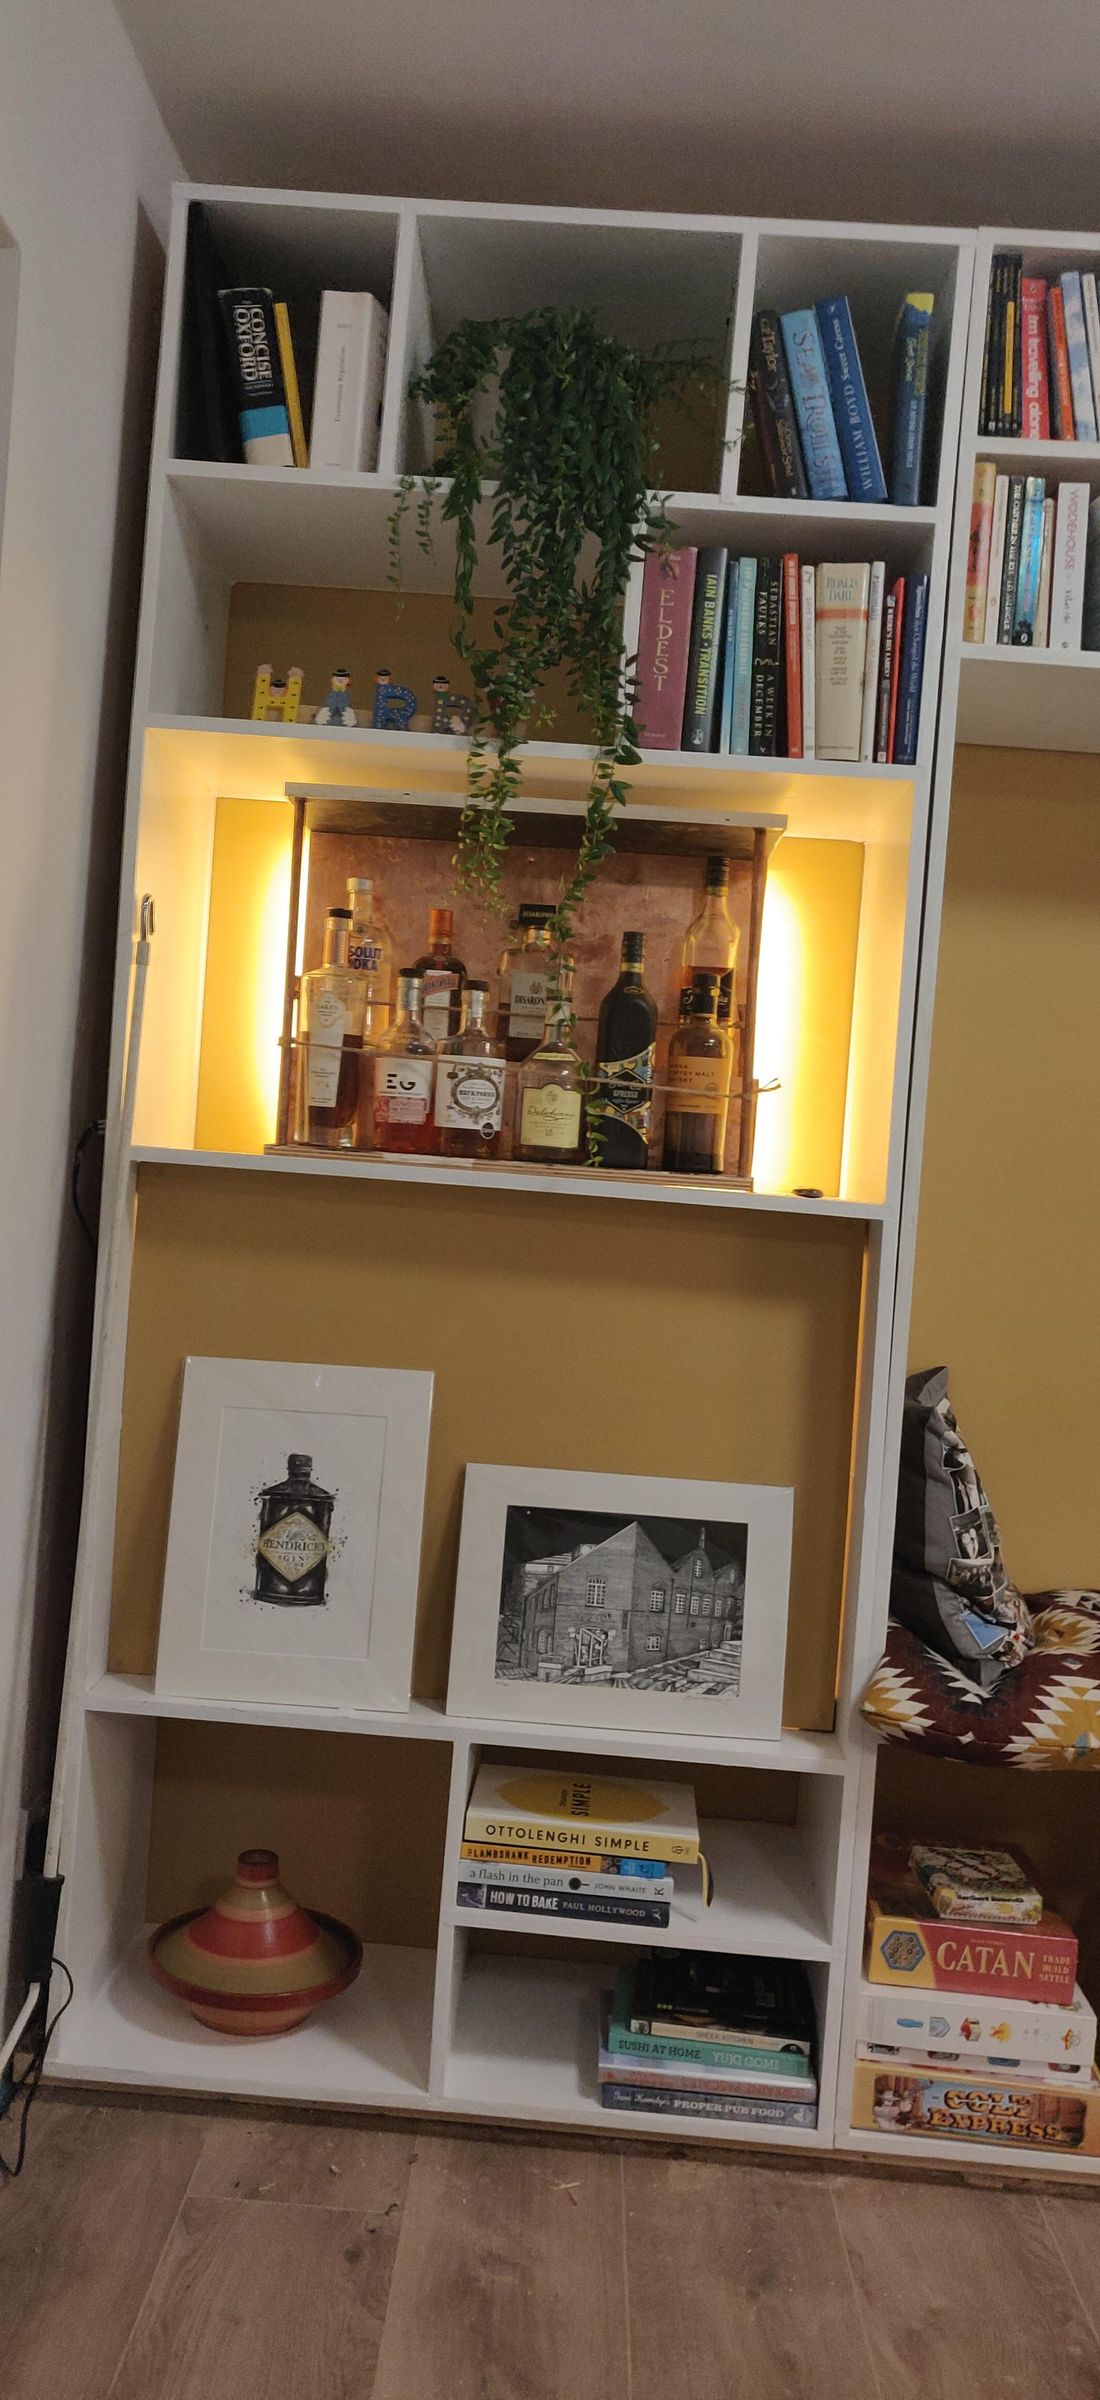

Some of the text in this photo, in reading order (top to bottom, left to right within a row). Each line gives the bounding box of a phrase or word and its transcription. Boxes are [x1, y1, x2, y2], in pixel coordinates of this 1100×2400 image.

[234, 309, 258, 381] OXFORD
[249, 308, 273, 379] CONCISE
[844, 385, 863, 425] BOYD
[852, 430, 873, 490] WILLIAM
[1064, 488, 1080, 571] WODEHOUSE
[826, 577, 857, 589] ROALD
[828, 590, 853, 601] DAHL
[756, 591, 768, 637] FAULKS
[767, 581, 780, 648] SEBASTIAN
[653, 589, 675, 693] ELDEST
[693, 573, 719, 717] IAIN BANKS TRANSITION
[754, 674, 766, 739] DECEMBER
[764, 674, 776, 739] A WEEK IN
[349, 945, 383, 960] SOLUT
[514, 994, 546, 1005] DISARON
[570, 1782, 592, 1817] SIMPLE
[485, 1824, 651, 1853] OTTOLENGHI SIMPLE
[474, 1848, 529, 1861] LAMBSHANK
[532, 1854, 592, 1867] REDEMPTION
[469, 1867, 647, 1895] a flash in the pan JOHN WHAITE
[490, 1890, 647, 1918] HOW TO BAKE PAUL HOLLYWOOD
[937, 1941, 1072, 1980] CATAN TRADE
[1042, 1964, 1070, 1975] BUILD
[1039, 1974, 1070, 1985] SETTLE
[617, 2039, 779, 2071] SUSHI AT HOME YUKI GOMI
[721, 2034, 754, 2045] KITCHEN
[673, 2100, 722, 2113] PROPER
[724, 2103, 750, 2115] PUB
[751, 2105, 785, 2119] FOOD
[944, 2089, 1033, 2118] COLT
[928, 2107, 1062, 2142] EXPRESS
